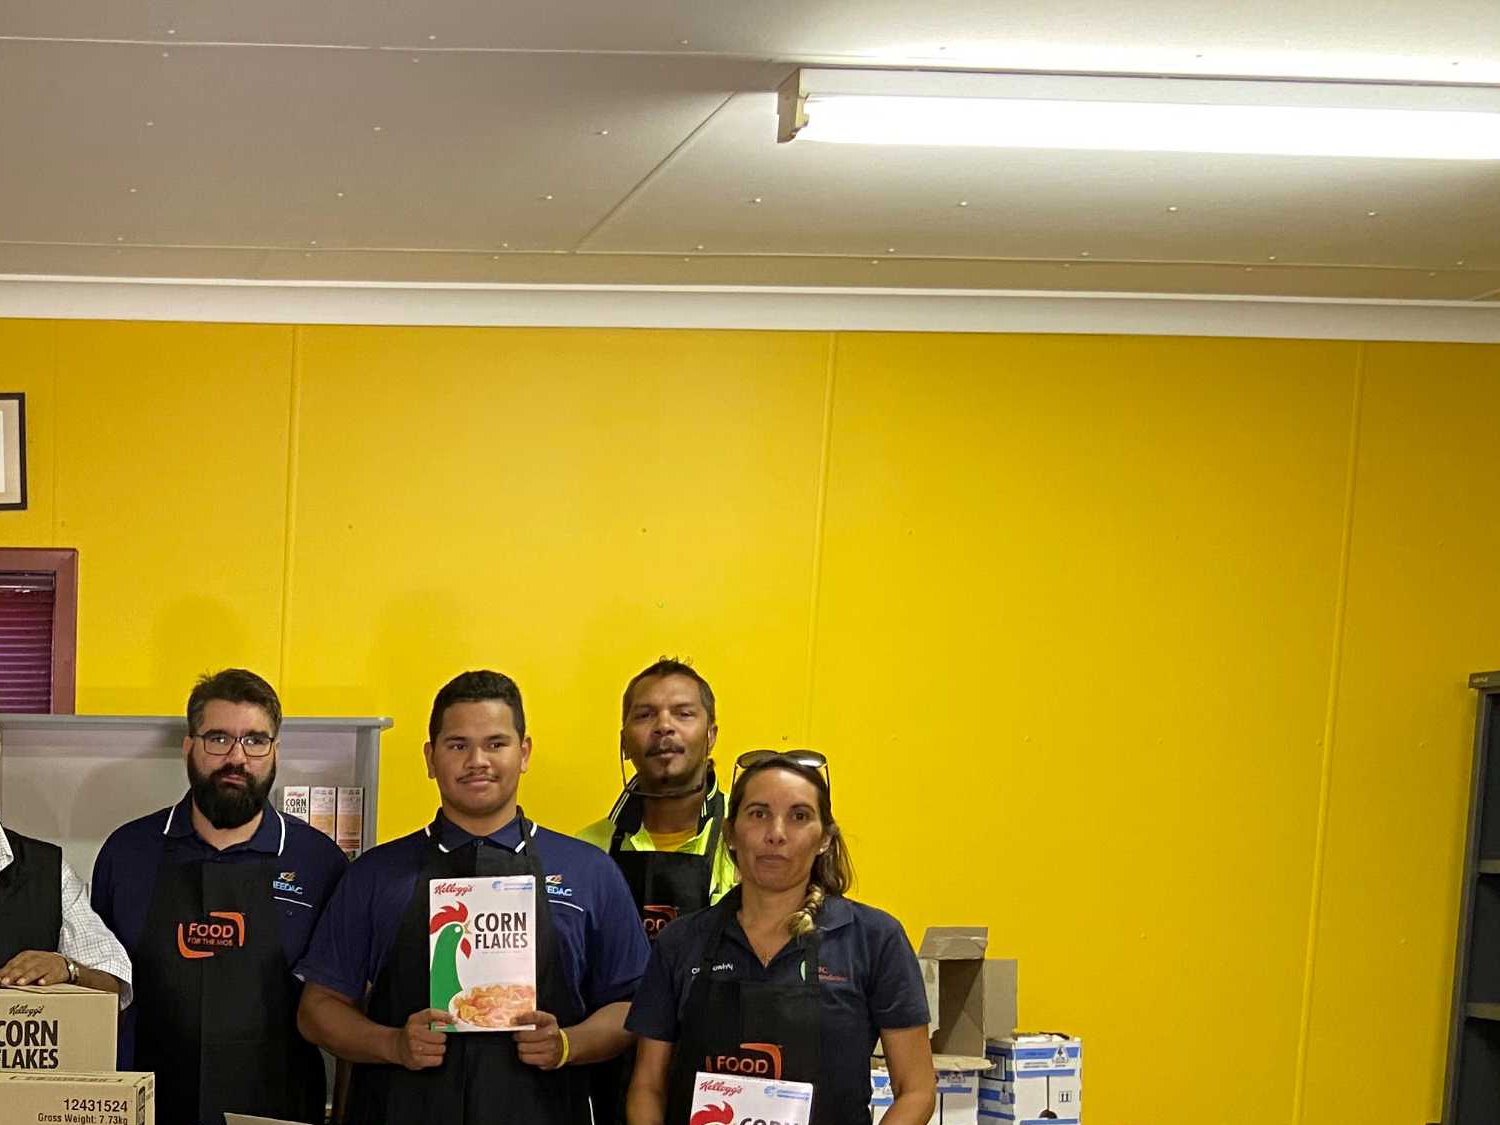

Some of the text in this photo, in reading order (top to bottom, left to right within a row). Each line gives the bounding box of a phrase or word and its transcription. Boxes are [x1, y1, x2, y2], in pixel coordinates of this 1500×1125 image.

[285, 798, 307, 807] CORN
[434, 883, 474, 896] Kellogg's
[189, 922, 234, 938] FOOD
[474, 911, 527, 933] CORN
[475, 933, 529, 949] FLAKES
[716, 1055, 769, 1074] FOOD
[699, 1079, 743, 1096] Kellogg's
[63, 1098, 128, 1112] 12431524
[37, 1112, 62, 1123] Gross
[64, 1113, 97, 1125] Weight:
